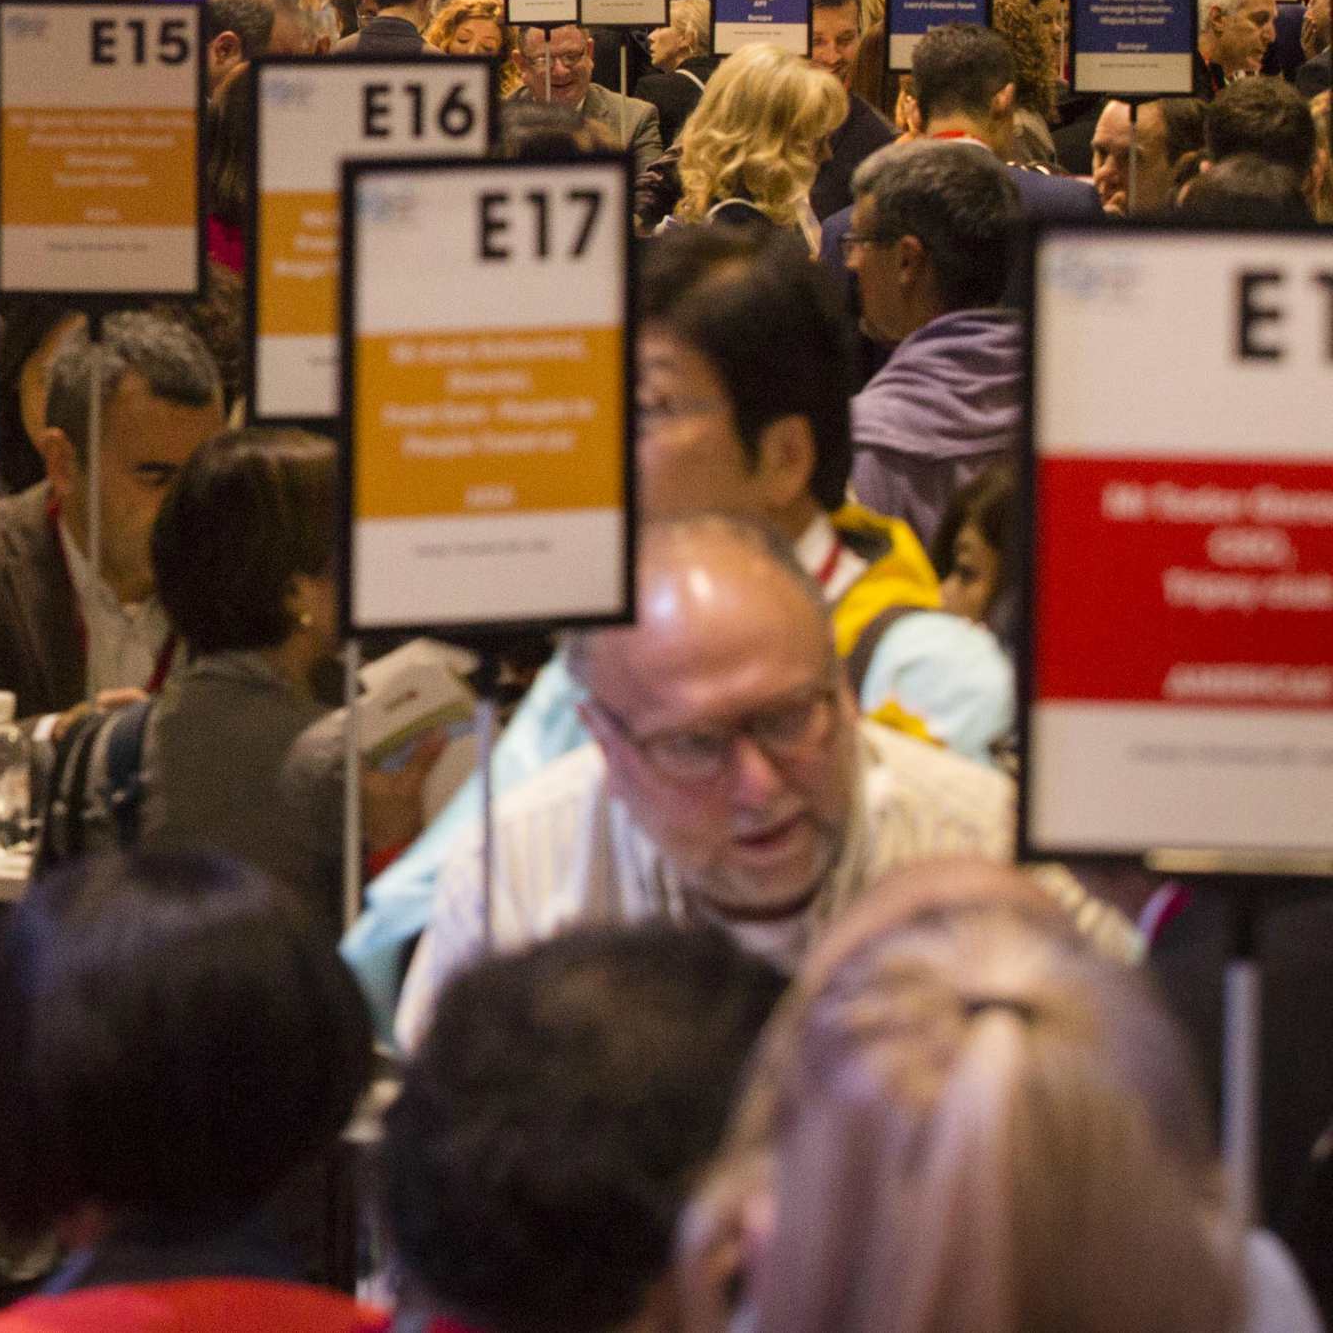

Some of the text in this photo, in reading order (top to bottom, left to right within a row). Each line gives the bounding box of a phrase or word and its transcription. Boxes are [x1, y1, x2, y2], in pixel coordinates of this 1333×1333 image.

[91, 19, 190, 65] E15
[362, 83, 474, 138] E16
[478, 188, 605, 261] E17
[1238, 271, 1333, 362] E1
